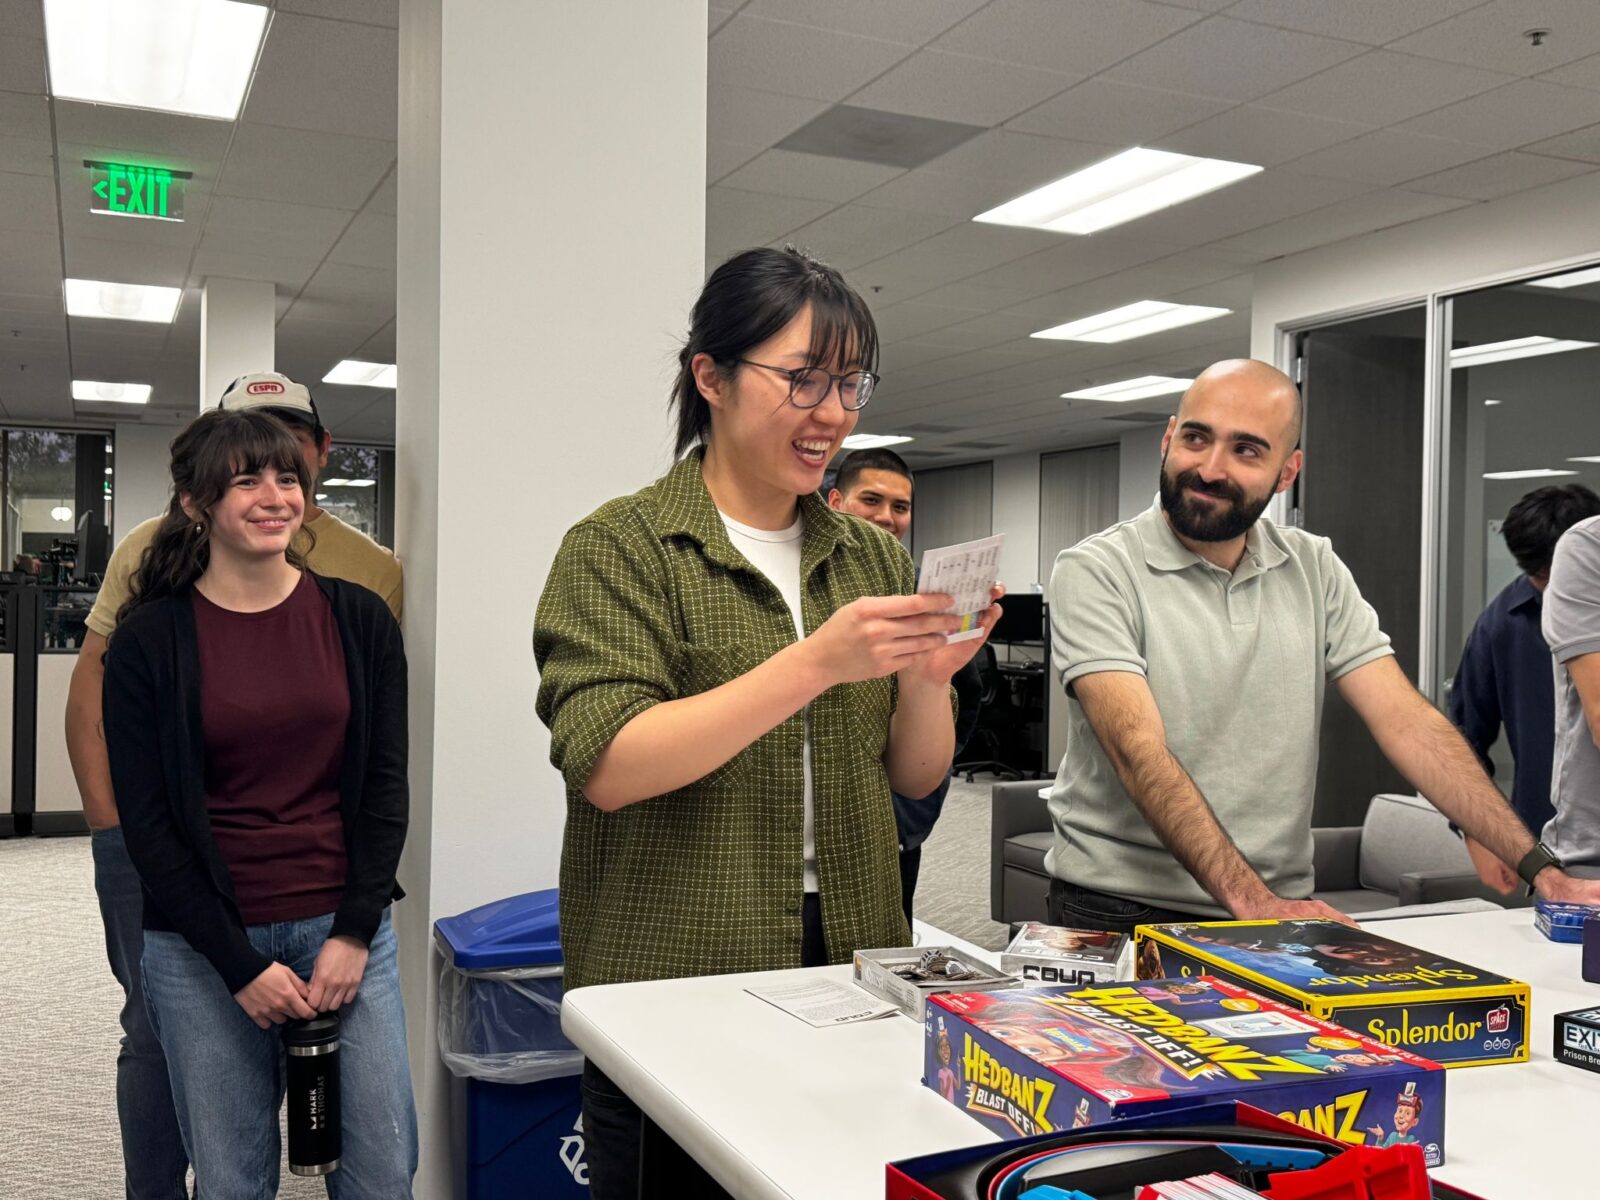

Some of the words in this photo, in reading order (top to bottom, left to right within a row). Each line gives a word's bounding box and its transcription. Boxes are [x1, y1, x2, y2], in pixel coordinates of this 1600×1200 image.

[109, 164, 173, 216] EXIT
[253, 384, 278, 393] ESPN
[1309, 965, 1478, 988] Splendor
[1063, 1004, 1153, 1034] BLAST
[1144, 1033, 1204, 1067] OFF!
[1064, 987, 1328, 1080] HEDBANZ
[1368, 1009, 1482, 1046] Splendor
[1563, 1049, 1587, 1061] Prison
[309, 1088, 317, 1114] MARK
[317, 1075, 325, 1113] THOMAS
[962, 1032, 1056, 1134] HEDBANZ
[975, 1088, 1006, 1111] BLAST
